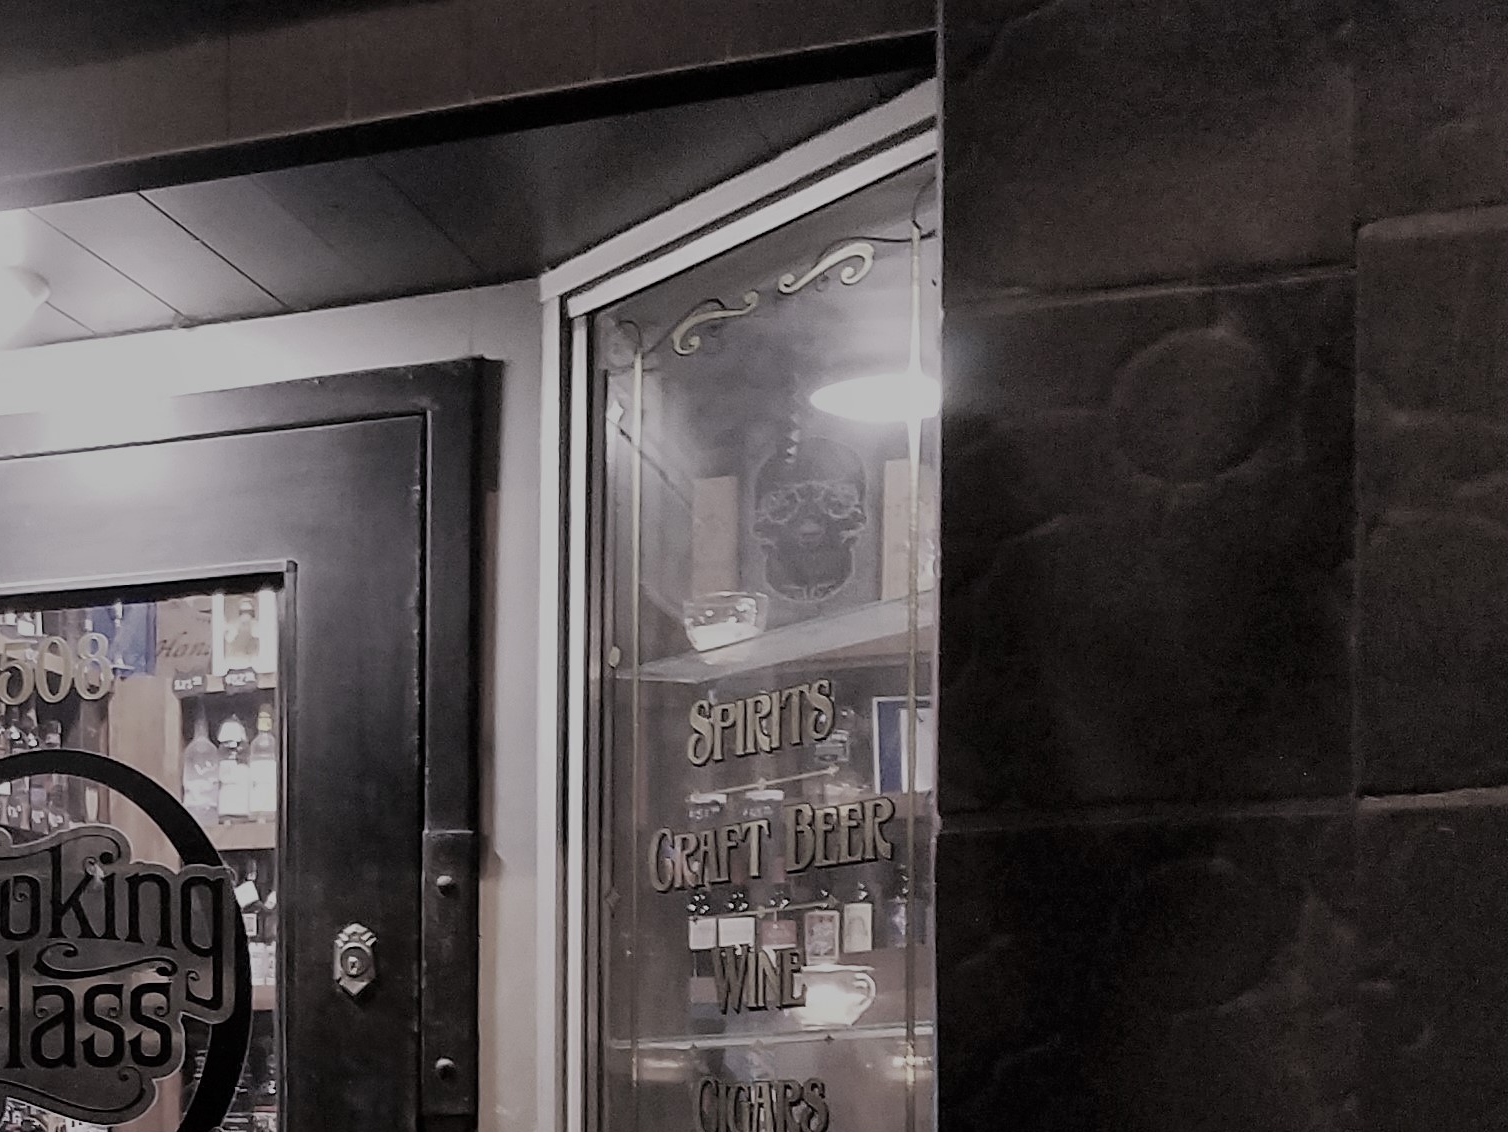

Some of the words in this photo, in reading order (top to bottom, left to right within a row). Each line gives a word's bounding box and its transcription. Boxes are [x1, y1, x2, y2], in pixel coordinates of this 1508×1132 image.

[687, 678, 836, 767] SPIRITS
[647, 816, 772, 894] CRAFT
[783, 796, 895, 875] BEER
[710, 945, 807, 1016] WINE
